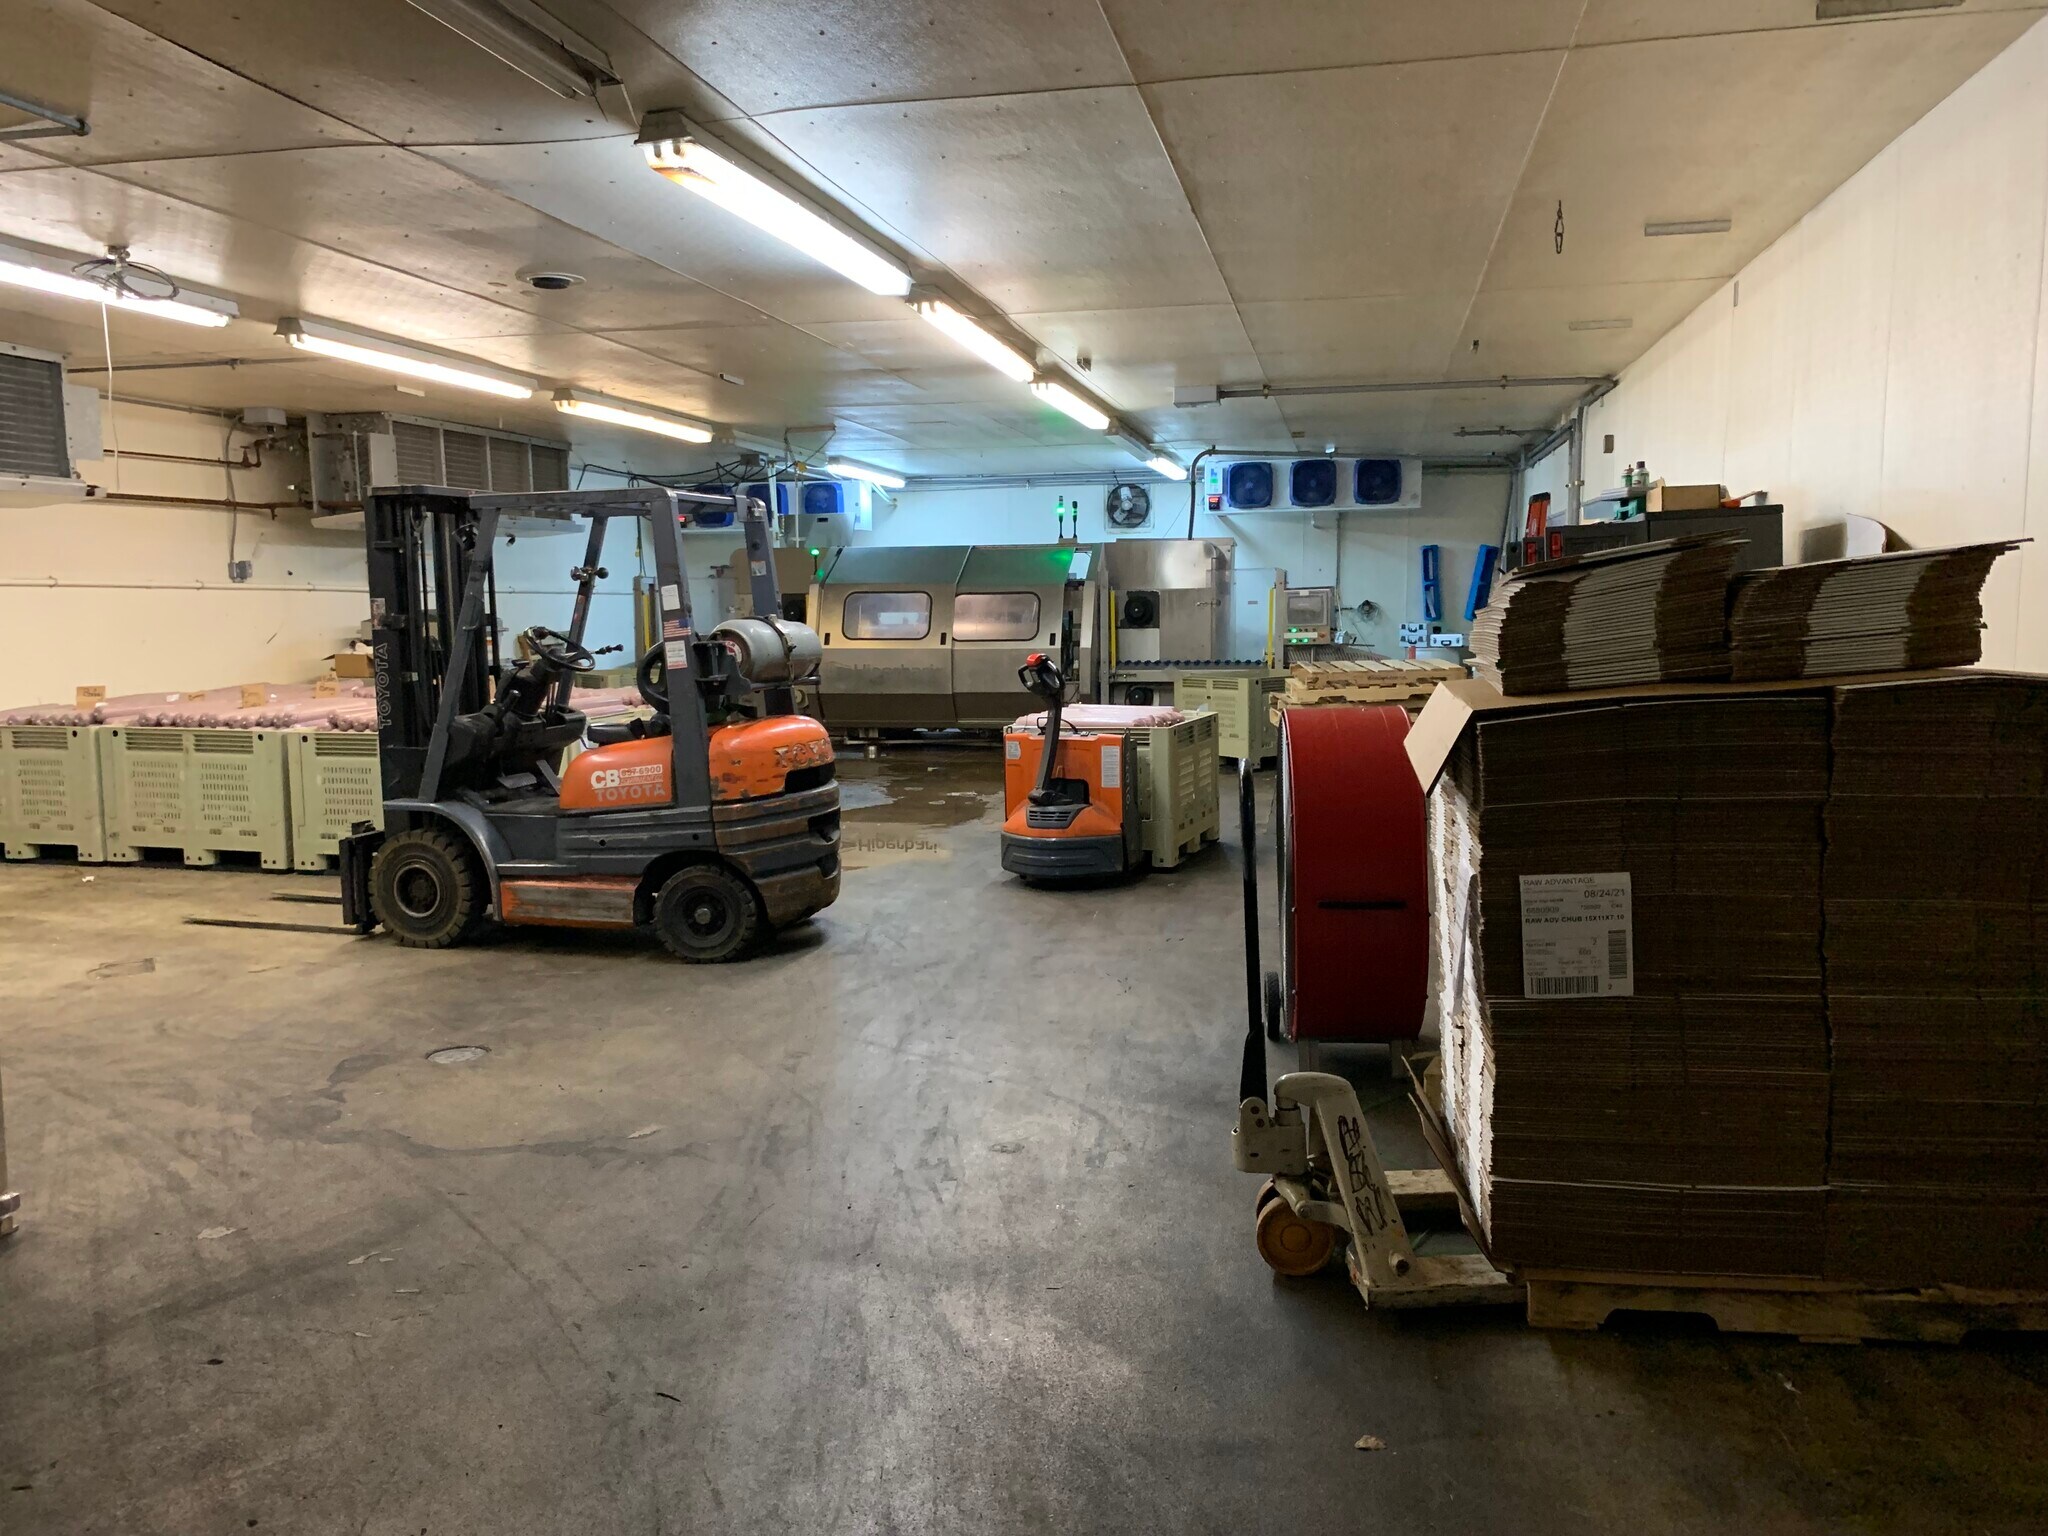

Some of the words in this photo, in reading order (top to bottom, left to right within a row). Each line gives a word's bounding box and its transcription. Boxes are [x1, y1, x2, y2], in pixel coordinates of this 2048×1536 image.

[375, 643, 392, 729] TOYOTA
[591, 769, 620, 788] CB
[594, 783, 665, 802] TOYOTA
[1523, 879, 1542, 887] RAW
[1545, 877, 1596, 886] ADVANTAGE
[1584, 889, 1625, 898] 08/24/21
